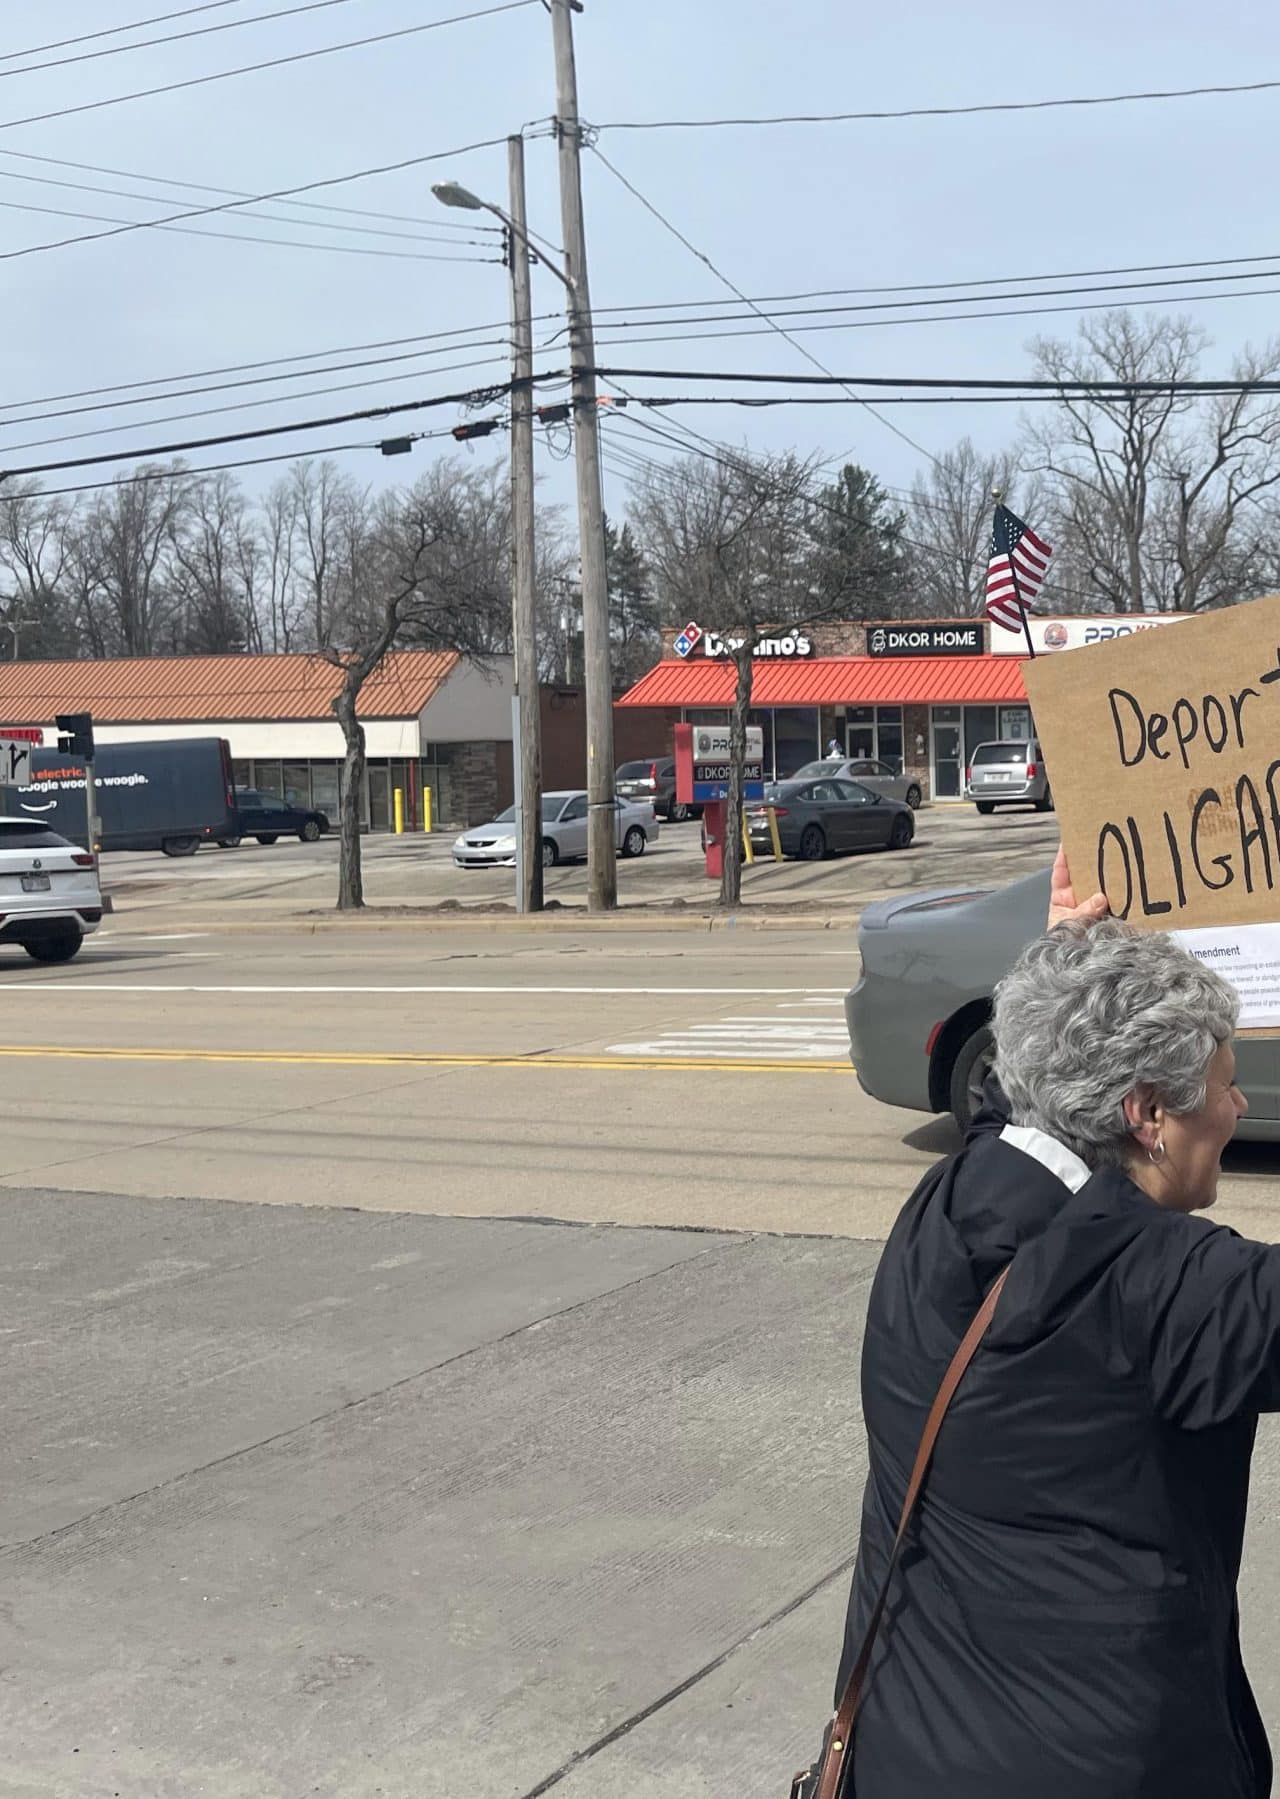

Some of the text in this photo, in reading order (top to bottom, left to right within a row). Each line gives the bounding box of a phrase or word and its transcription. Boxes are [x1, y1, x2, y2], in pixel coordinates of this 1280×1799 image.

[889, 631, 977, 648] DKOR HOME
[37, 766, 86, 779] electric.
[60, 778, 102, 789] wooe
